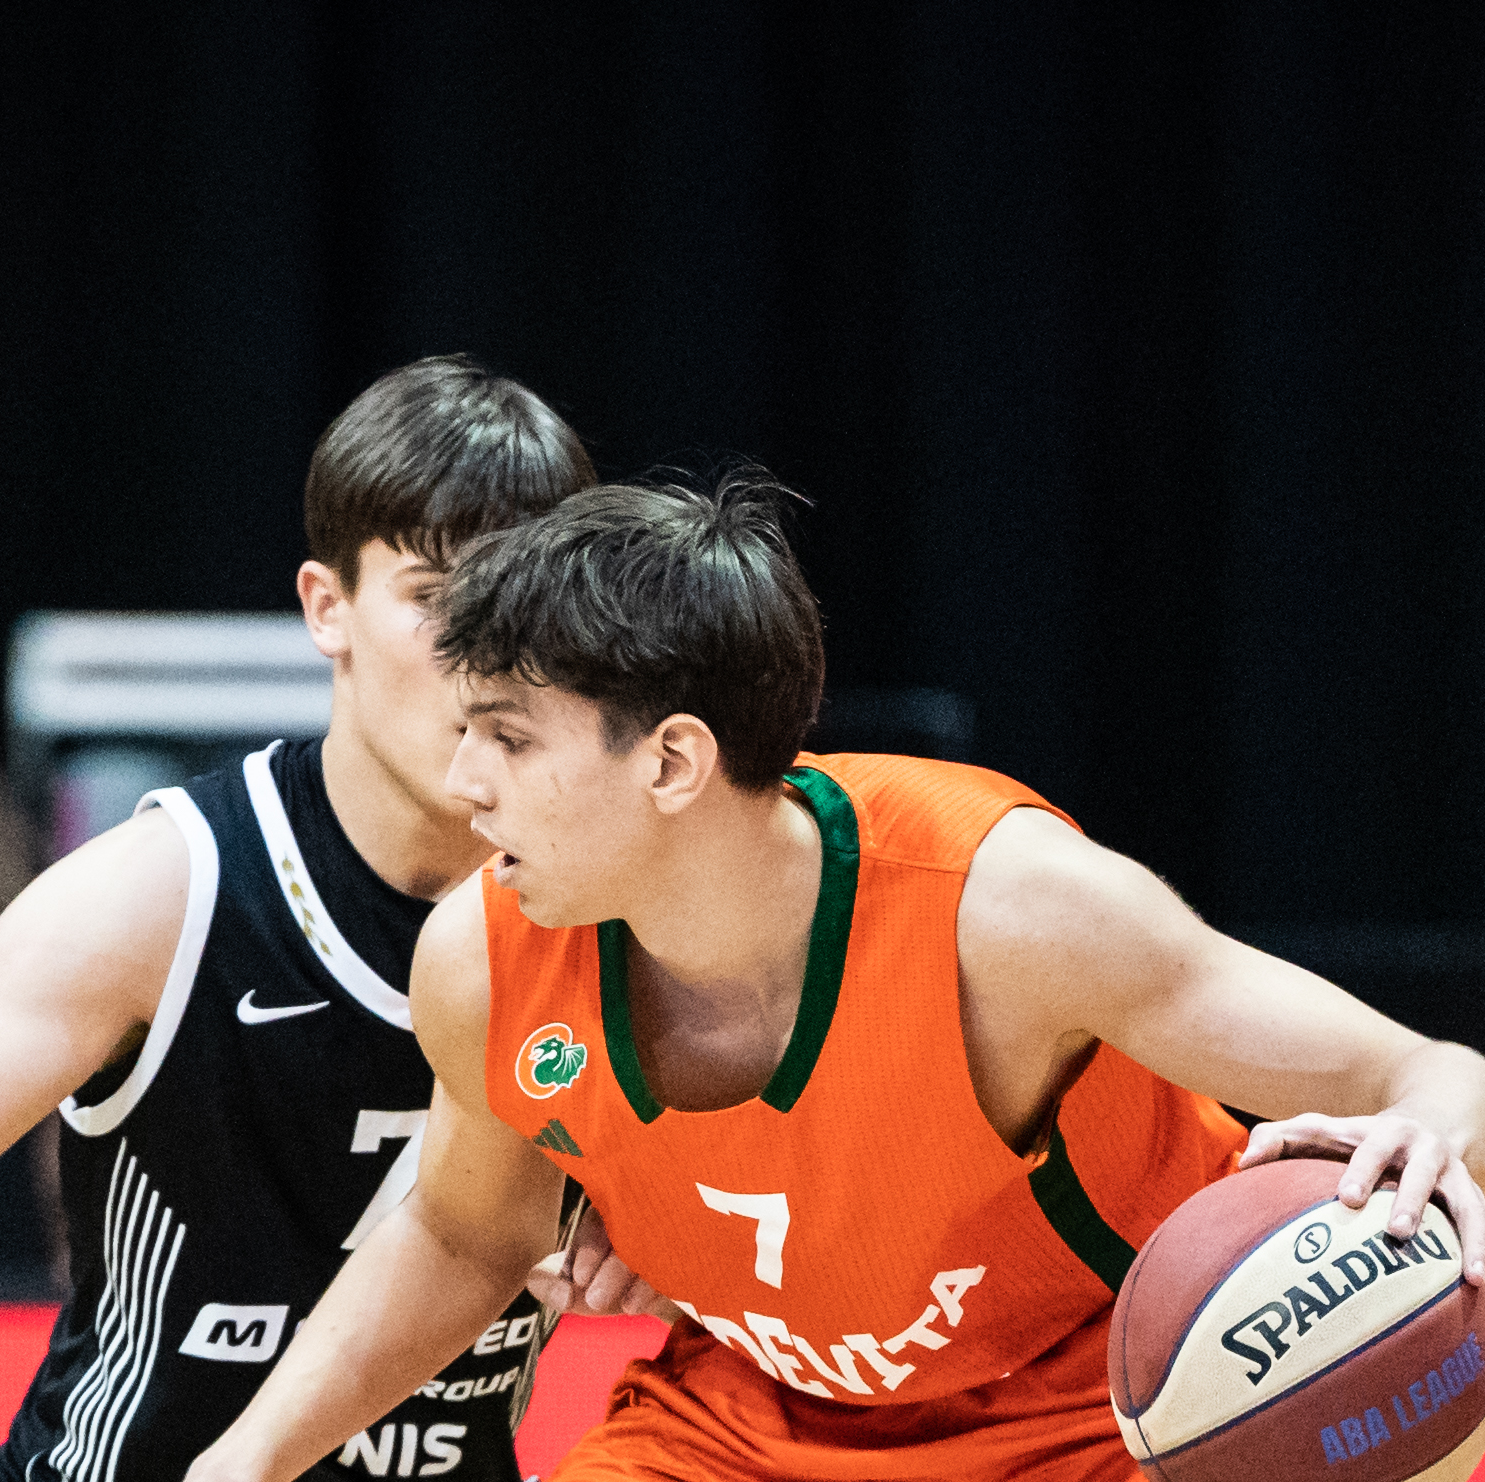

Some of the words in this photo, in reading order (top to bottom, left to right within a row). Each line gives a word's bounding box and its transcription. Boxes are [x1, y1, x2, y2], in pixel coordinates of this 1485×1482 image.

[340, 1109, 430, 1250] 7
[695, 1182, 790, 1290] 7
[671, 1265, 988, 1399] DEVITA
[1220, 1229, 1453, 1386] SPALDING
[337, 1422, 468, 1478] NIS
[1320, 1406, 1392, 1465] ABA
[1392, 1331, 1485, 1432] LEAGUE
